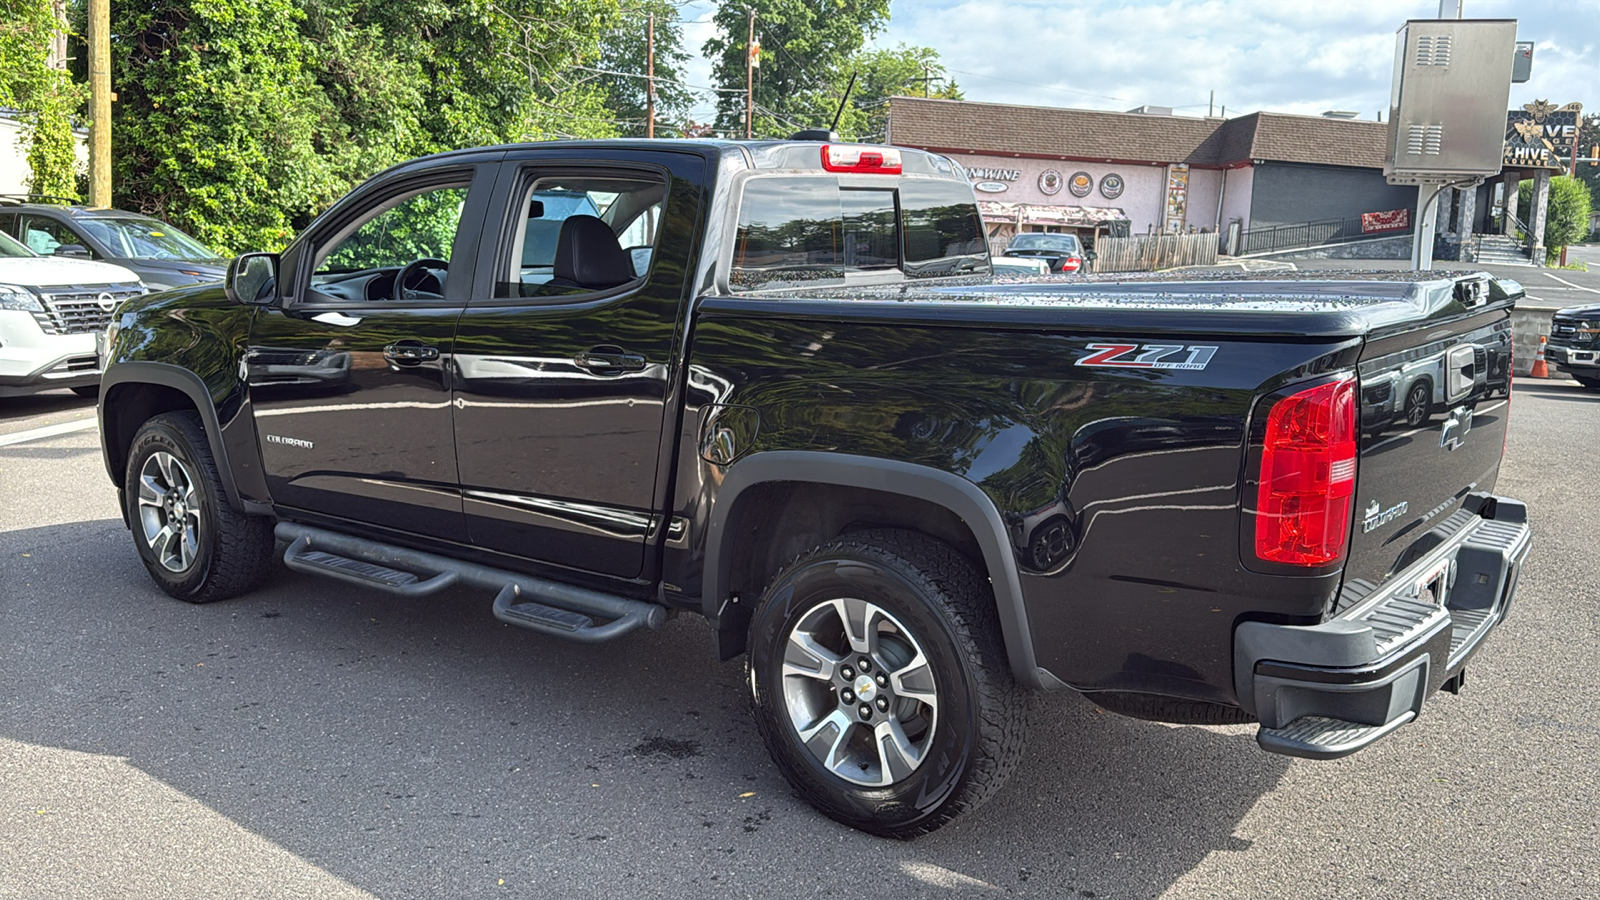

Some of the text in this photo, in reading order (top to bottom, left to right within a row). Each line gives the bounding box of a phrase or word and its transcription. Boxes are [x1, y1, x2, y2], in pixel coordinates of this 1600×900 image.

[1515, 147, 1549, 160] HIVE
[984, 168, 1021, 182] WINE
[1074, 343, 1219, 369] Z71
[266, 434, 313, 448] COLORADO
